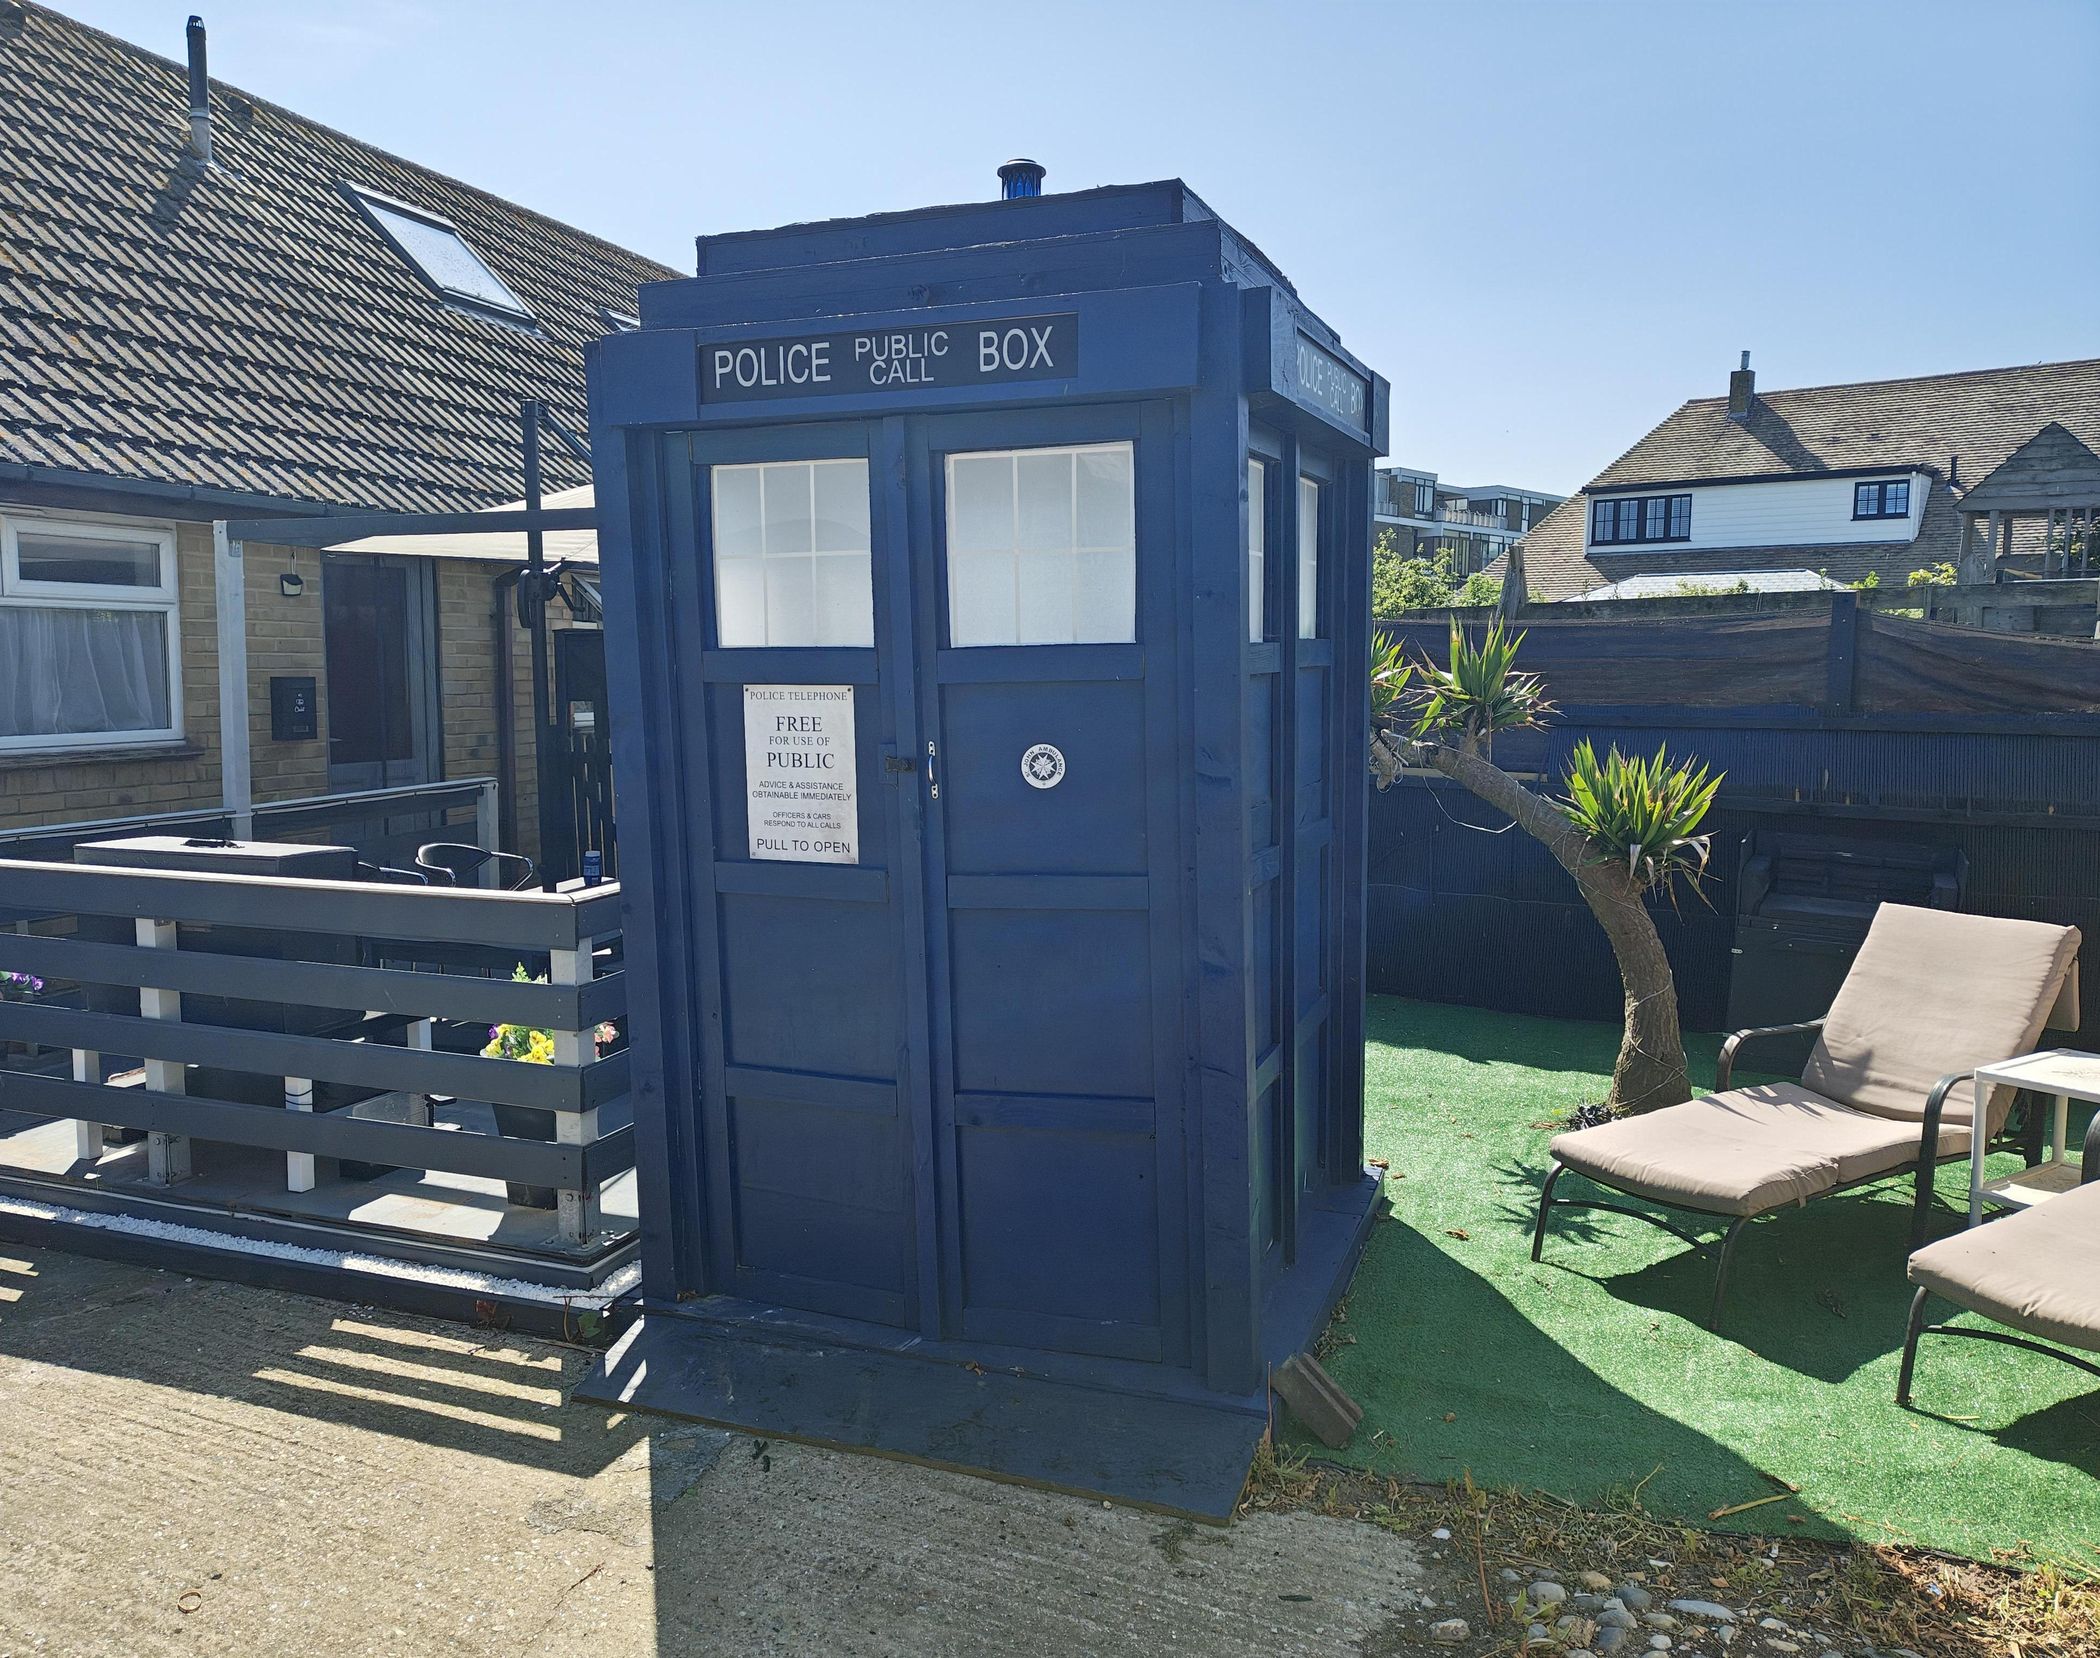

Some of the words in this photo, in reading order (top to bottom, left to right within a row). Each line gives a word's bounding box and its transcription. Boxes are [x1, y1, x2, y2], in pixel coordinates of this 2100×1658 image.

[854, 331, 949, 362] PUBLIC
[979, 325, 1054, 372] BOX
[714, 341, 831, 389] POLICE
[869, 358, 935, 386] CALL
[1330, 386, 1344, 414] CALL
[750, 691, 785, 700] POLICE
[788, 692, 847, 700] TELEPHONE
[776, 716, 823, 732] FREE
[769, 736, 790, 745] FOR
[793, 736, 813, 745] USE
[816, 737, 830, 746] OF
[767, 752, 835, 769] PUBLIC
[1024, 750, 1035, 767] JOHN
[1039, 747, 1063, 776] AMBULANCE
[759, 781, 787, 789] ADVICE
[789, 781, 794, 789] &
[795, 782, 844, 790] ASSISTANCE
[752, 791, 799, 799] OBTAINABLE
[800, 792, 851, 801] IMMEDIATELY
[812, 812, 831, 820] CARS
[797, 820, 806, 828] TO
[820, 821, 841, 829] CALLS
[757, 838, 788, 851] PULL
[792, 839, 809, 852] TO
[814, 841, 850, 853] OPEN
